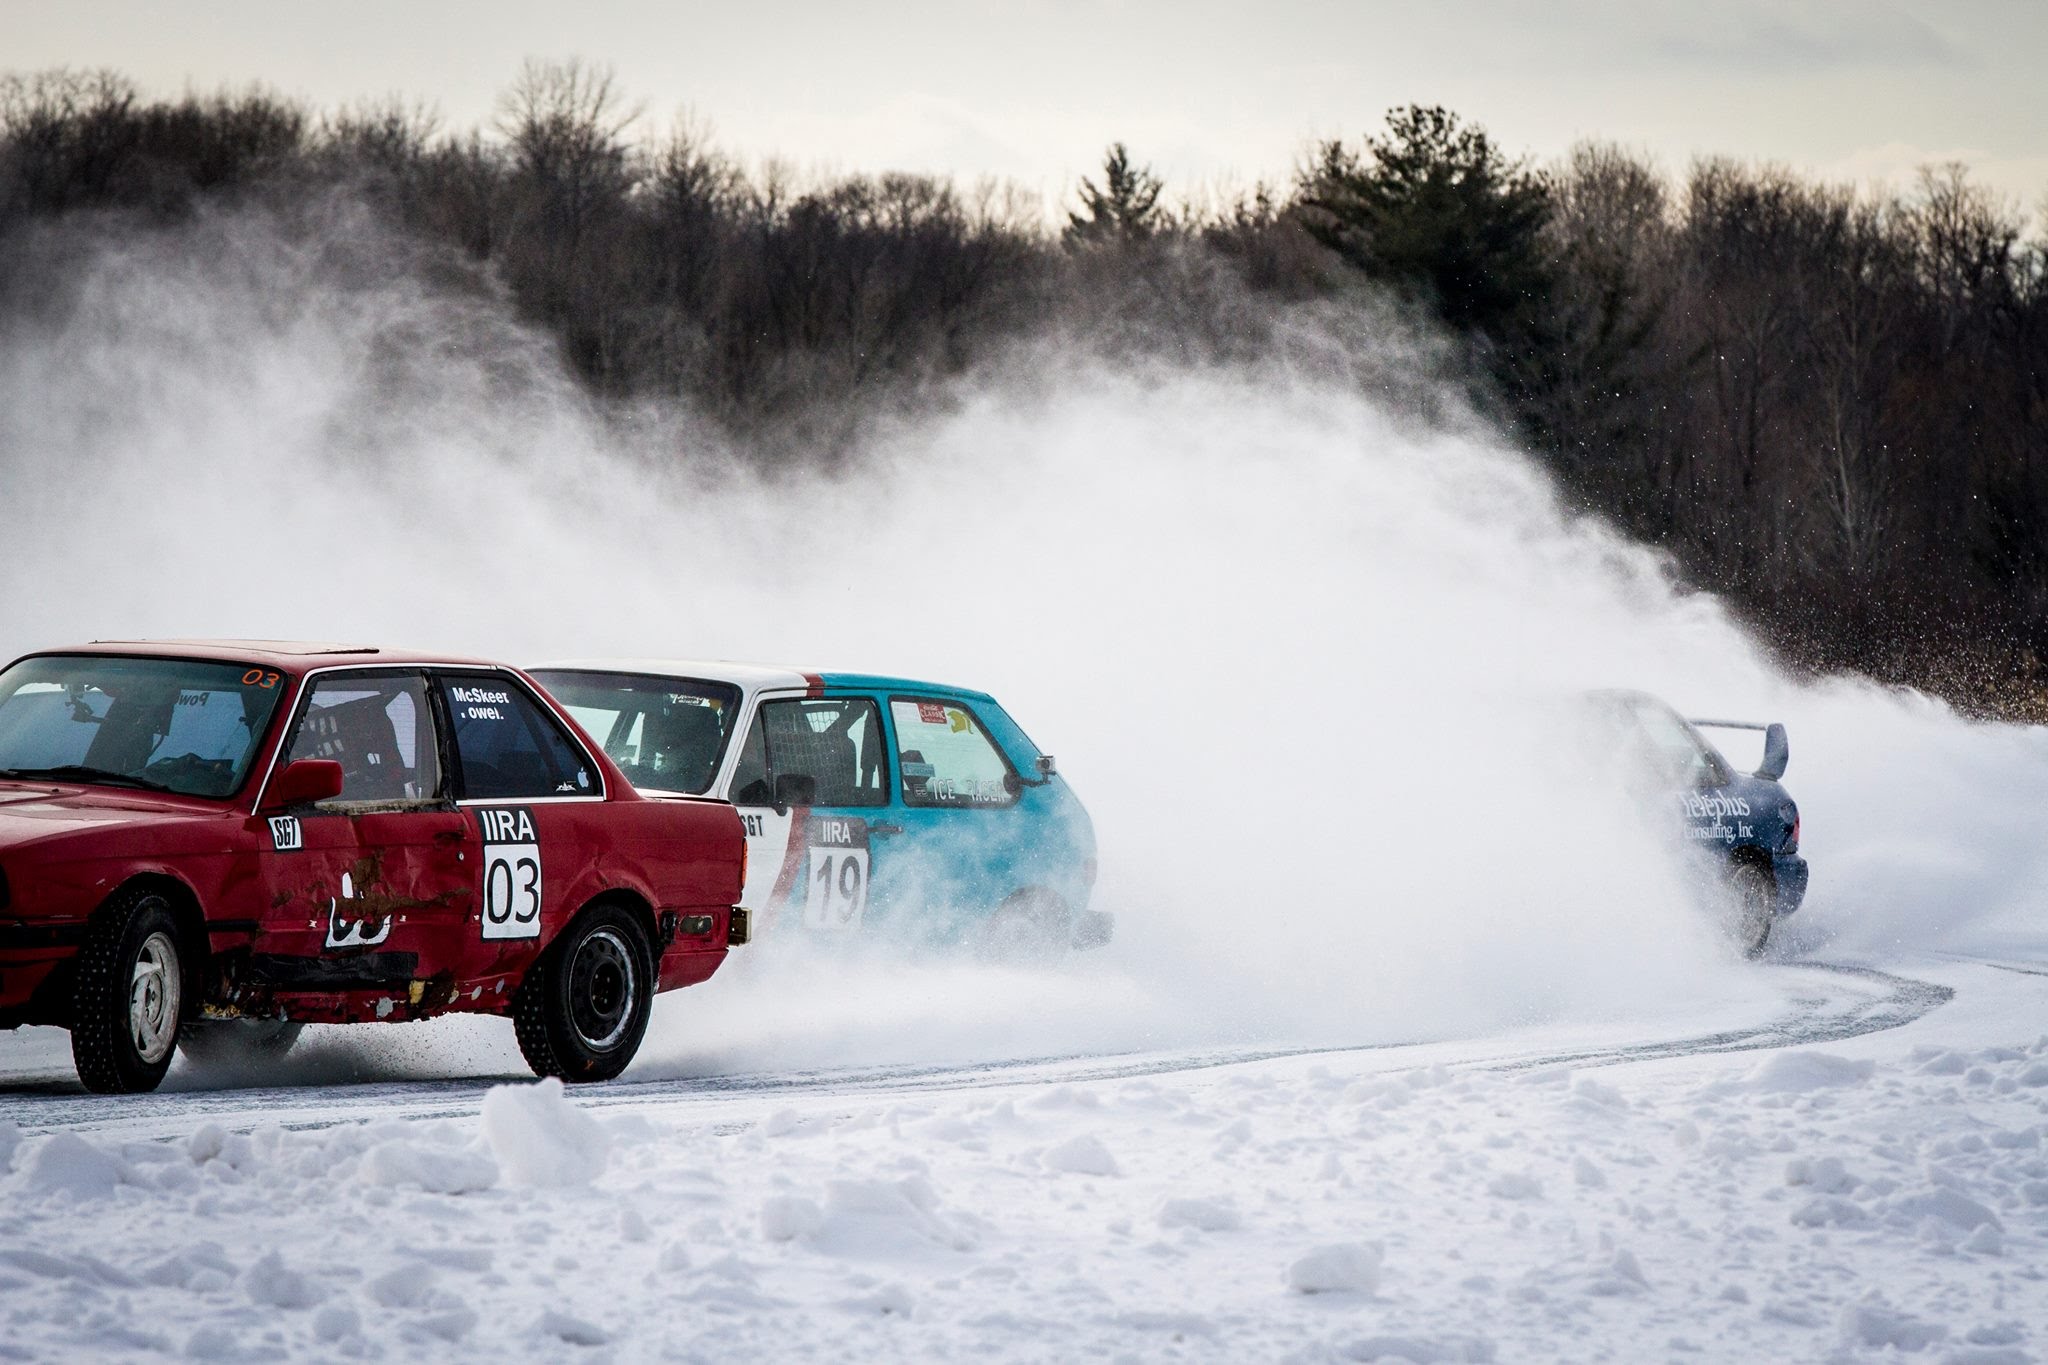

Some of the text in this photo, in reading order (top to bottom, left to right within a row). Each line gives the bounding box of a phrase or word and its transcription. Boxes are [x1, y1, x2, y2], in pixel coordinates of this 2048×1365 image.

[240, 669, 280, 689] 03
[932, 779, 956, 800] ICE
[1676, 789, 1750, 827] Teleplus
[274, 818, 297, 847] SGT
[480, 810, 536, 842] IIRA
[822, 821, 852, 843] IIRA
[486, 857, 540, 924] 03
[816, 855, 861, 923] 19
